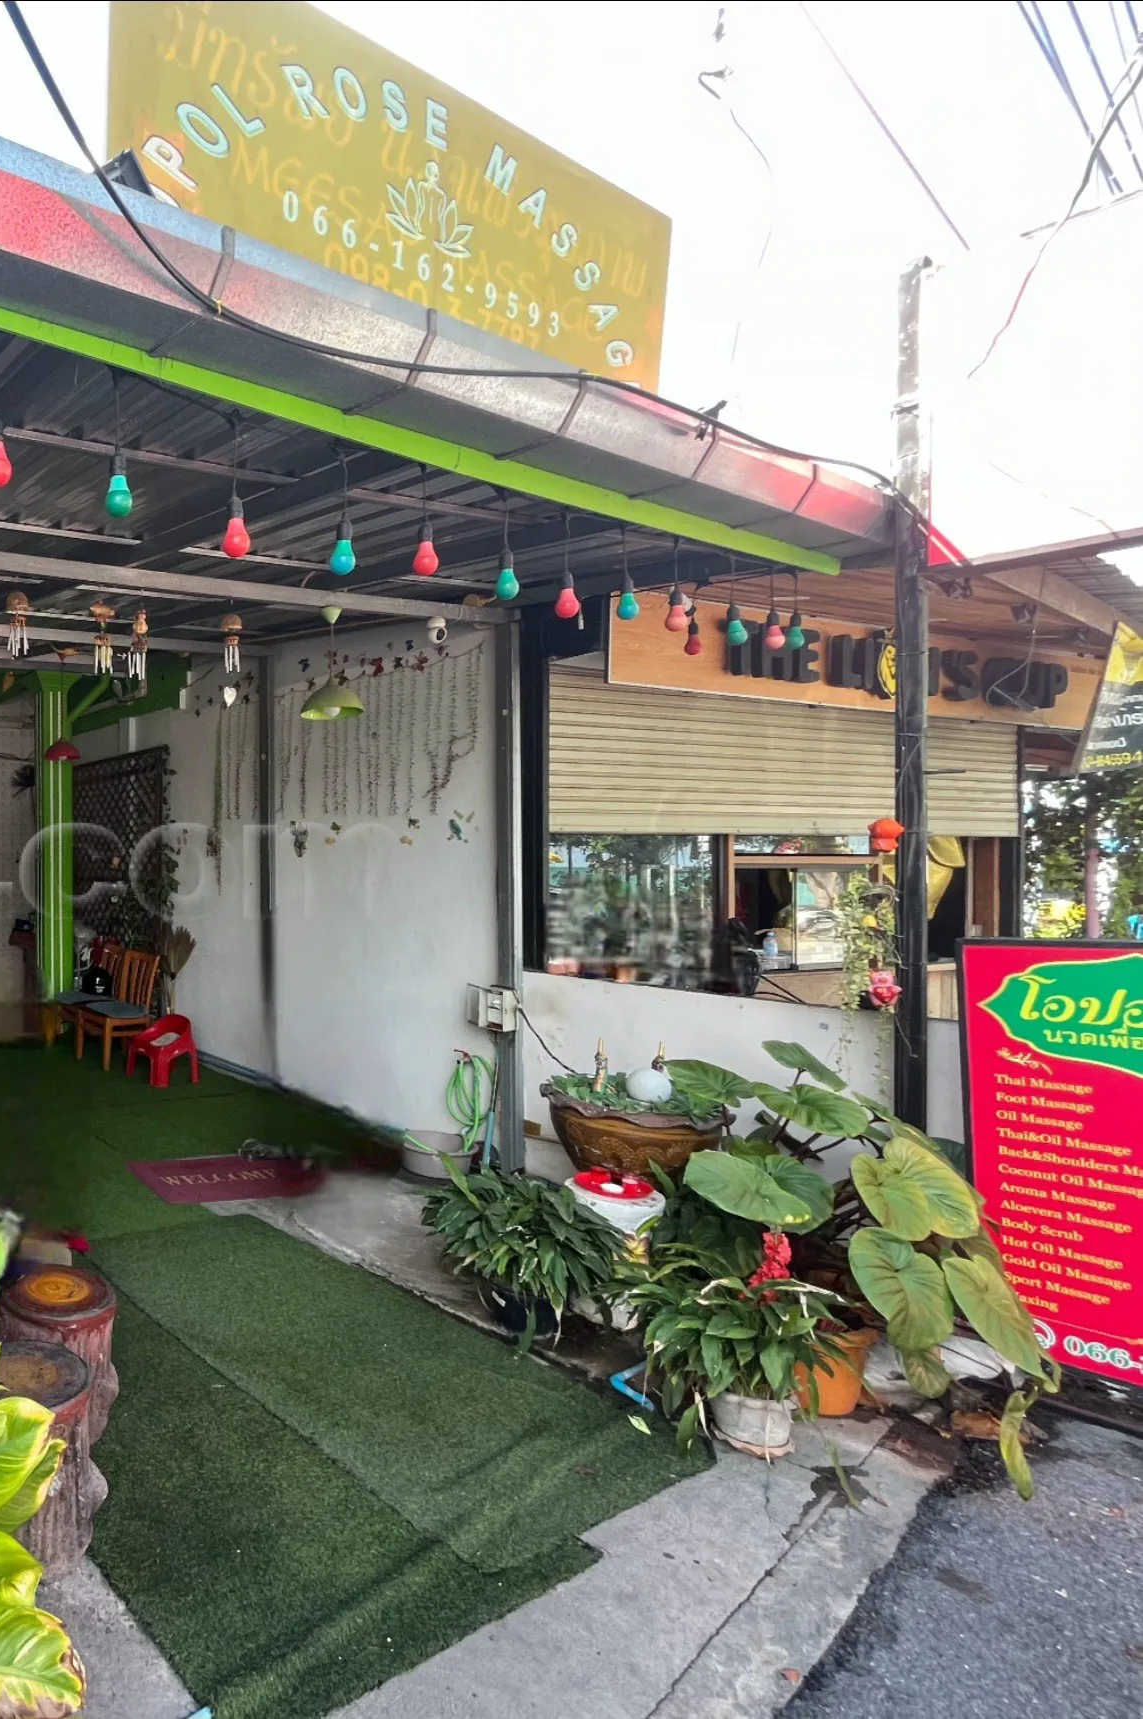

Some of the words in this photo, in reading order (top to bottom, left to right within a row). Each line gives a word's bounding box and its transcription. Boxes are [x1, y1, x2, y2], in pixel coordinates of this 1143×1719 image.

[279, 63, 449, 152] ROSE
[484, 143, 642, 388] MASSAG
[282, 189, 561, 338] 066-162-9593
[718, 617, 821, 684] THE
[994, 1073, 1026, 1087] Thai
[1029, 1077, 1093, 1095] Massage
[995, 1091, 1027, 1105] Foot
[1031, 1096, 1095, 1114] Massage
[995, 1109, 1017, 1121] Oil
[1020, 1112, 1083, 1131] Massage
[996, 1127, 1062, 1146] Thai&Oil
[1065, 1137, 1133, 1157] Massage
[998, 1145, 1119, 1173] Back&Shoulders
[159, 1167, 279, 1188] WELCOME
[998, 1163, 1058, 1182] Coconut
[1060, 1173, 1084, 1187] Oil
[999, 1181, 1048, 1198] Aroma
[1051, 1190, 1117, 1211] Massage
[1000, 1199, 1063, 1220] Aloevera
[1066, 1211, 1133, 1233] Massage
[1001, 1217, 1037, 1234] Body
[1039, 1224, 1084, 1242] Scrub
[1001, 1235, 1029, 1249] Hot
[1031, 1241, 1055, 1255] Oil
[1058, 1246, 1124, 1269] Massage
[1002, 1253, 1037, 1269] Gold
[1039, 1261, 1062, 1275] Oil
[1065, 1267, 1133, 1291] Massage
[1004, 1271, 1042, 1288] Sport
[1045, 1280, 1111, 1305] Massage
[1016, 1292, 1059, 1313] axing
